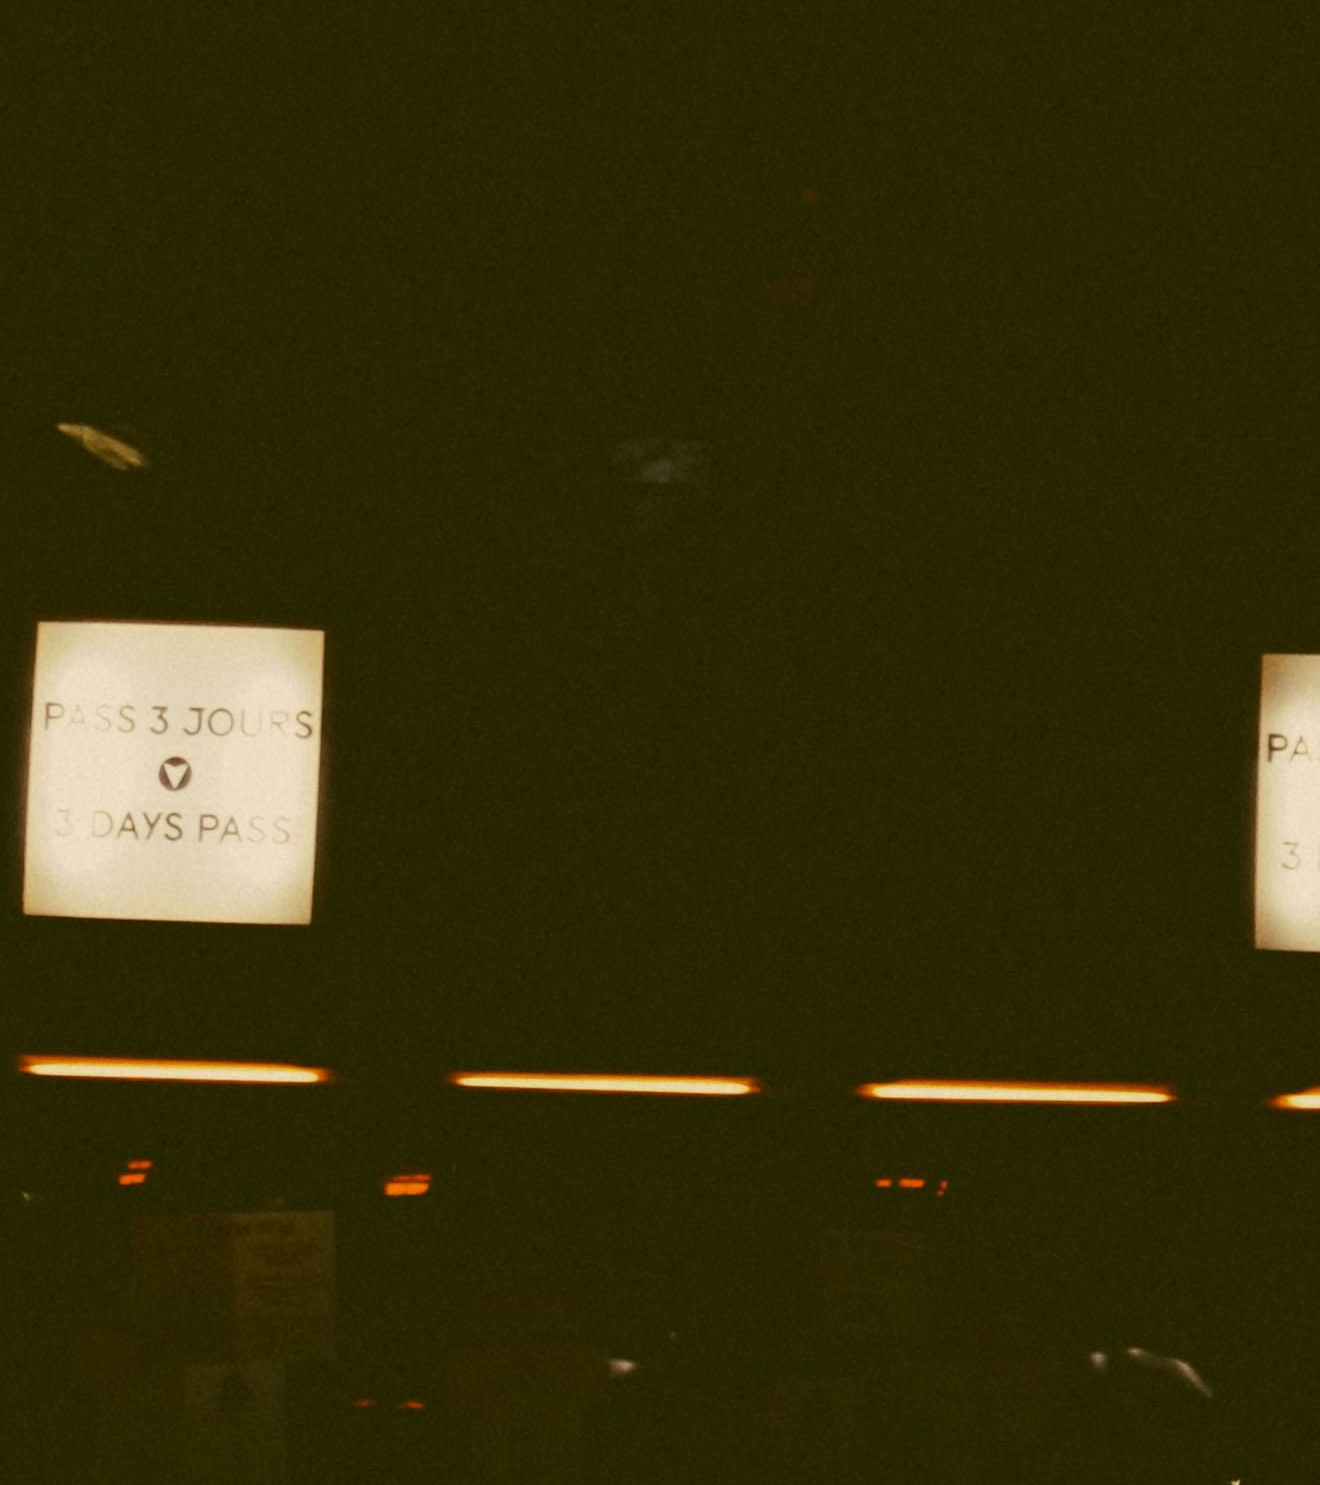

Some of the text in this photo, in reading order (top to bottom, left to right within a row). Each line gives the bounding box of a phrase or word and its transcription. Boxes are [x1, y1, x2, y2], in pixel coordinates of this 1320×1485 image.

[44, 702, 313, 739] PASS 3 JOURS
[56, 809, 290, 844] 3 DAYS PASS
[1281, 842, 1300, 870] 3
